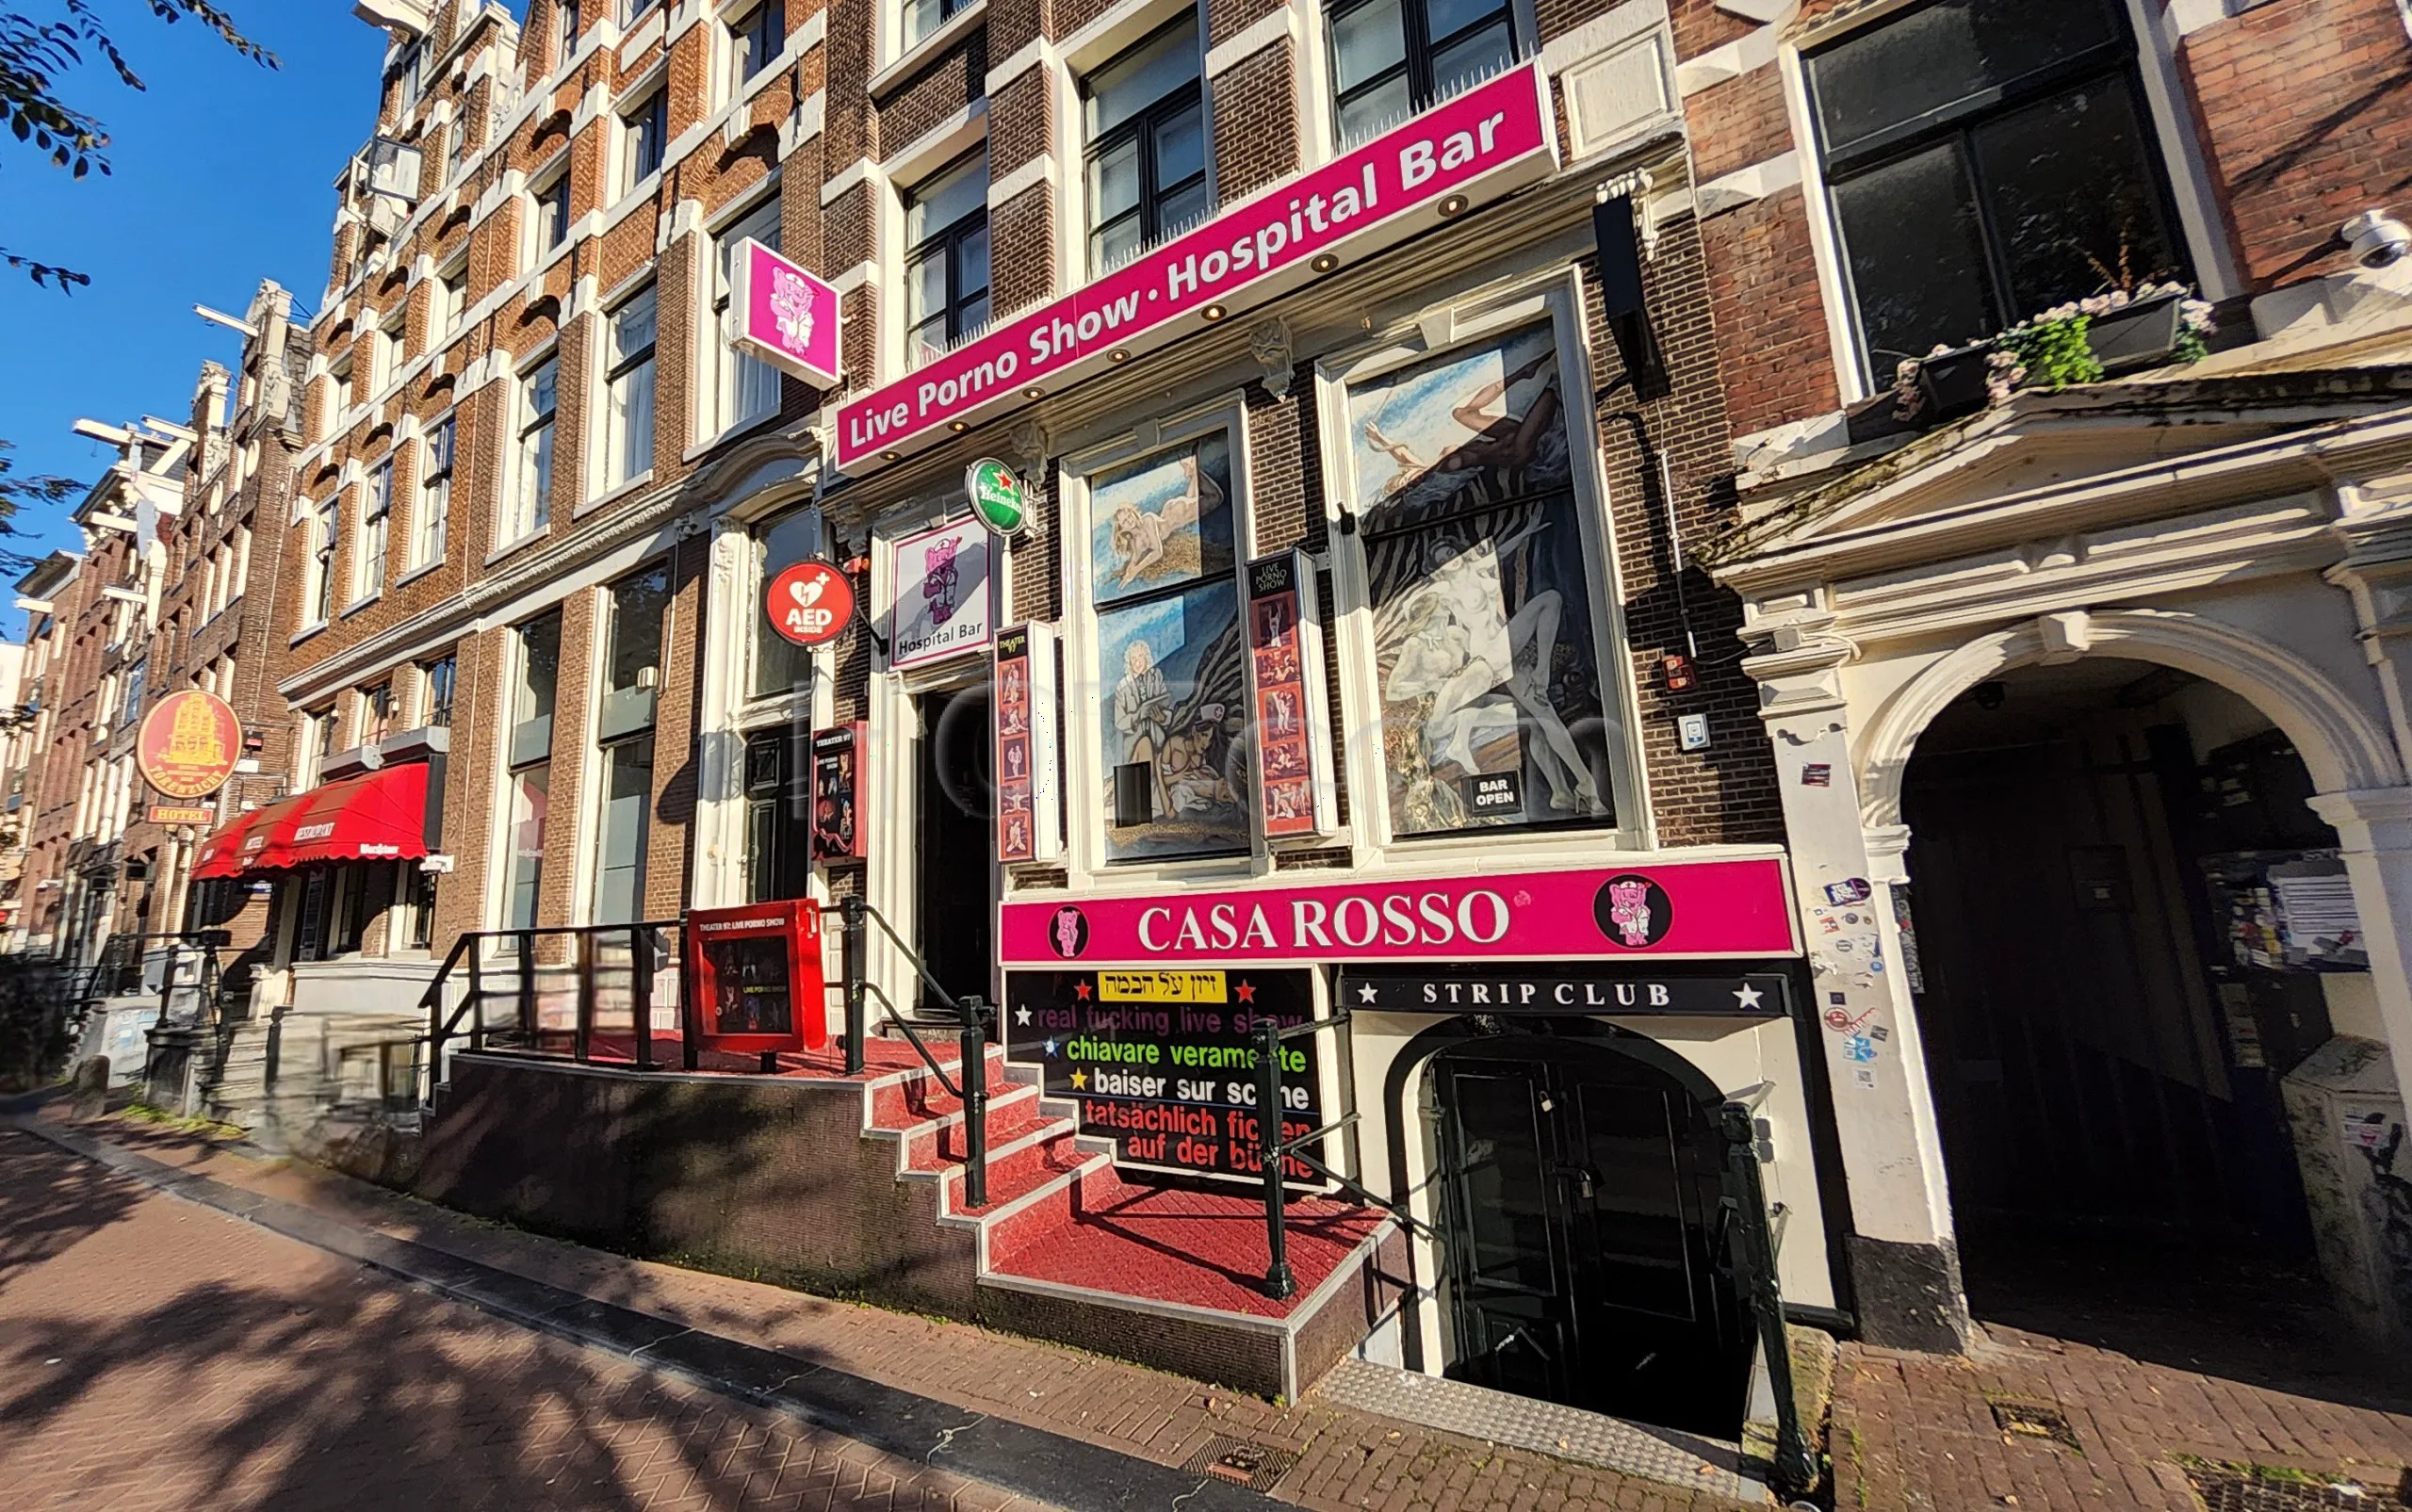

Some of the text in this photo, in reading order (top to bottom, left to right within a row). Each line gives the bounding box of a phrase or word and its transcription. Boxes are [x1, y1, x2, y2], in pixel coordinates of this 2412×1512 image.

[851, 111, 1505, 448] Live Porno Show Hospital Bar
[1256, 569, 1287, 584] PORNO
[1262, 562, 1279, 575] LIVE
[1259, 578, 1284, 592] SHOW
[785, 608, 833, 626] AED
[794, 626, 823, 634] INSIDE
[899, 623, 983, 655] Hospital Bar
[1000, 635, 1025, 648] THEATER
[816, 733, 851, 747] THEATER 97
[1479, 779, 1508, 792] BAR
[1475, 791, 1514, 806] OPEN
[157, 809, 204, 821] HOTEL
[699, 922, 723, 932] THEATER
[732, 920, 743, 929] LIVE
[766, 918, 785, 926] SHOW
[1138, 889, 1510, 951] CASA ROSSO
[1423, 983, 1670, 1006] STRIP CLUB
[1037, 1004, 1303, 1037] real fucking live shw
[1067, 1035, 1306, 1072] chiavare veramete
[1095, 1067, 1309, 1110] baiser sur scne
[1085, 1099, 1312, 1146] tatsächlich ficen
[1128, 1133, 1313, 1178] auf der büne
